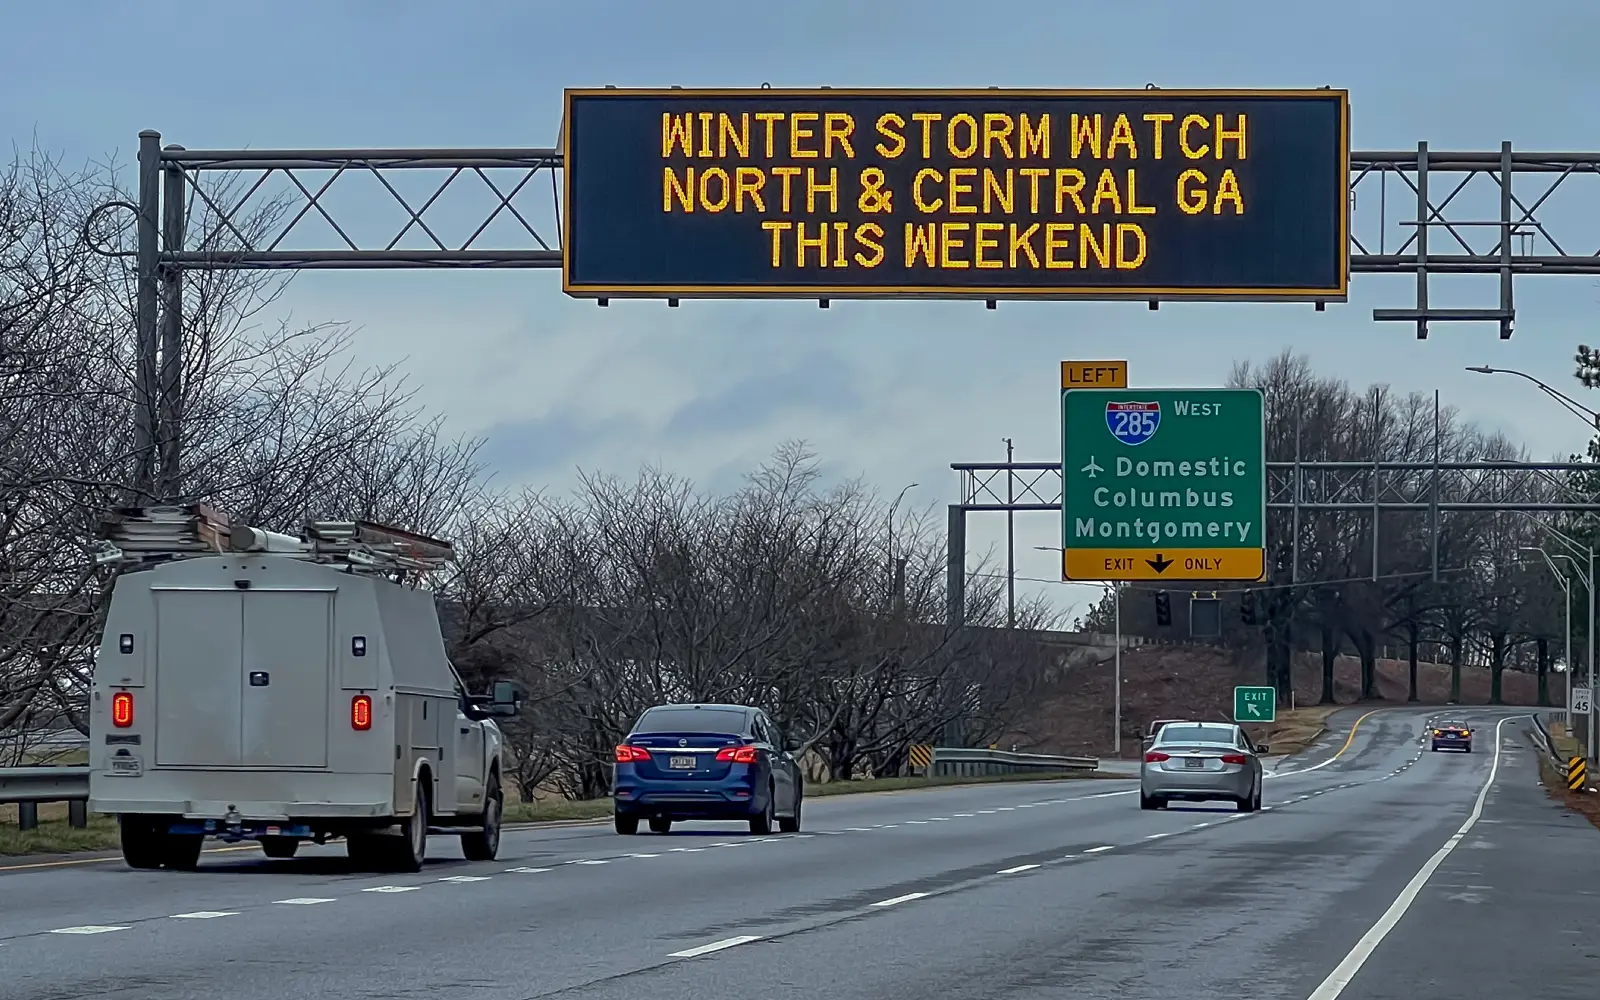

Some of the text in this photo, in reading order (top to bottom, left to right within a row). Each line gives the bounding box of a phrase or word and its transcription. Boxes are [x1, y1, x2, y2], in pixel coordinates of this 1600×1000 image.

[662, 112, 1246, 159] WINTER STORM WATCH
[663, 167, 1244, 214] NORTH & CENTRAL GA
[761, 222, 1147, 269] THIS WEEKEND
[1069, 367, 1119, 383] LEFT
[1174, 400, 1222, 416] WEST
[1114, 412, 1155, 436] 285
[1116, 456, 1246, 477] Domestic
[1093, 487, 1234, 508] Columbus
[1075, 517, 1252, 544] Montgomery
[1104, 558, 1222, 570] EXIT ONLY
[1244, 692, 1267, 701] EXIT
[1574, 701, 1588, 711] 45
